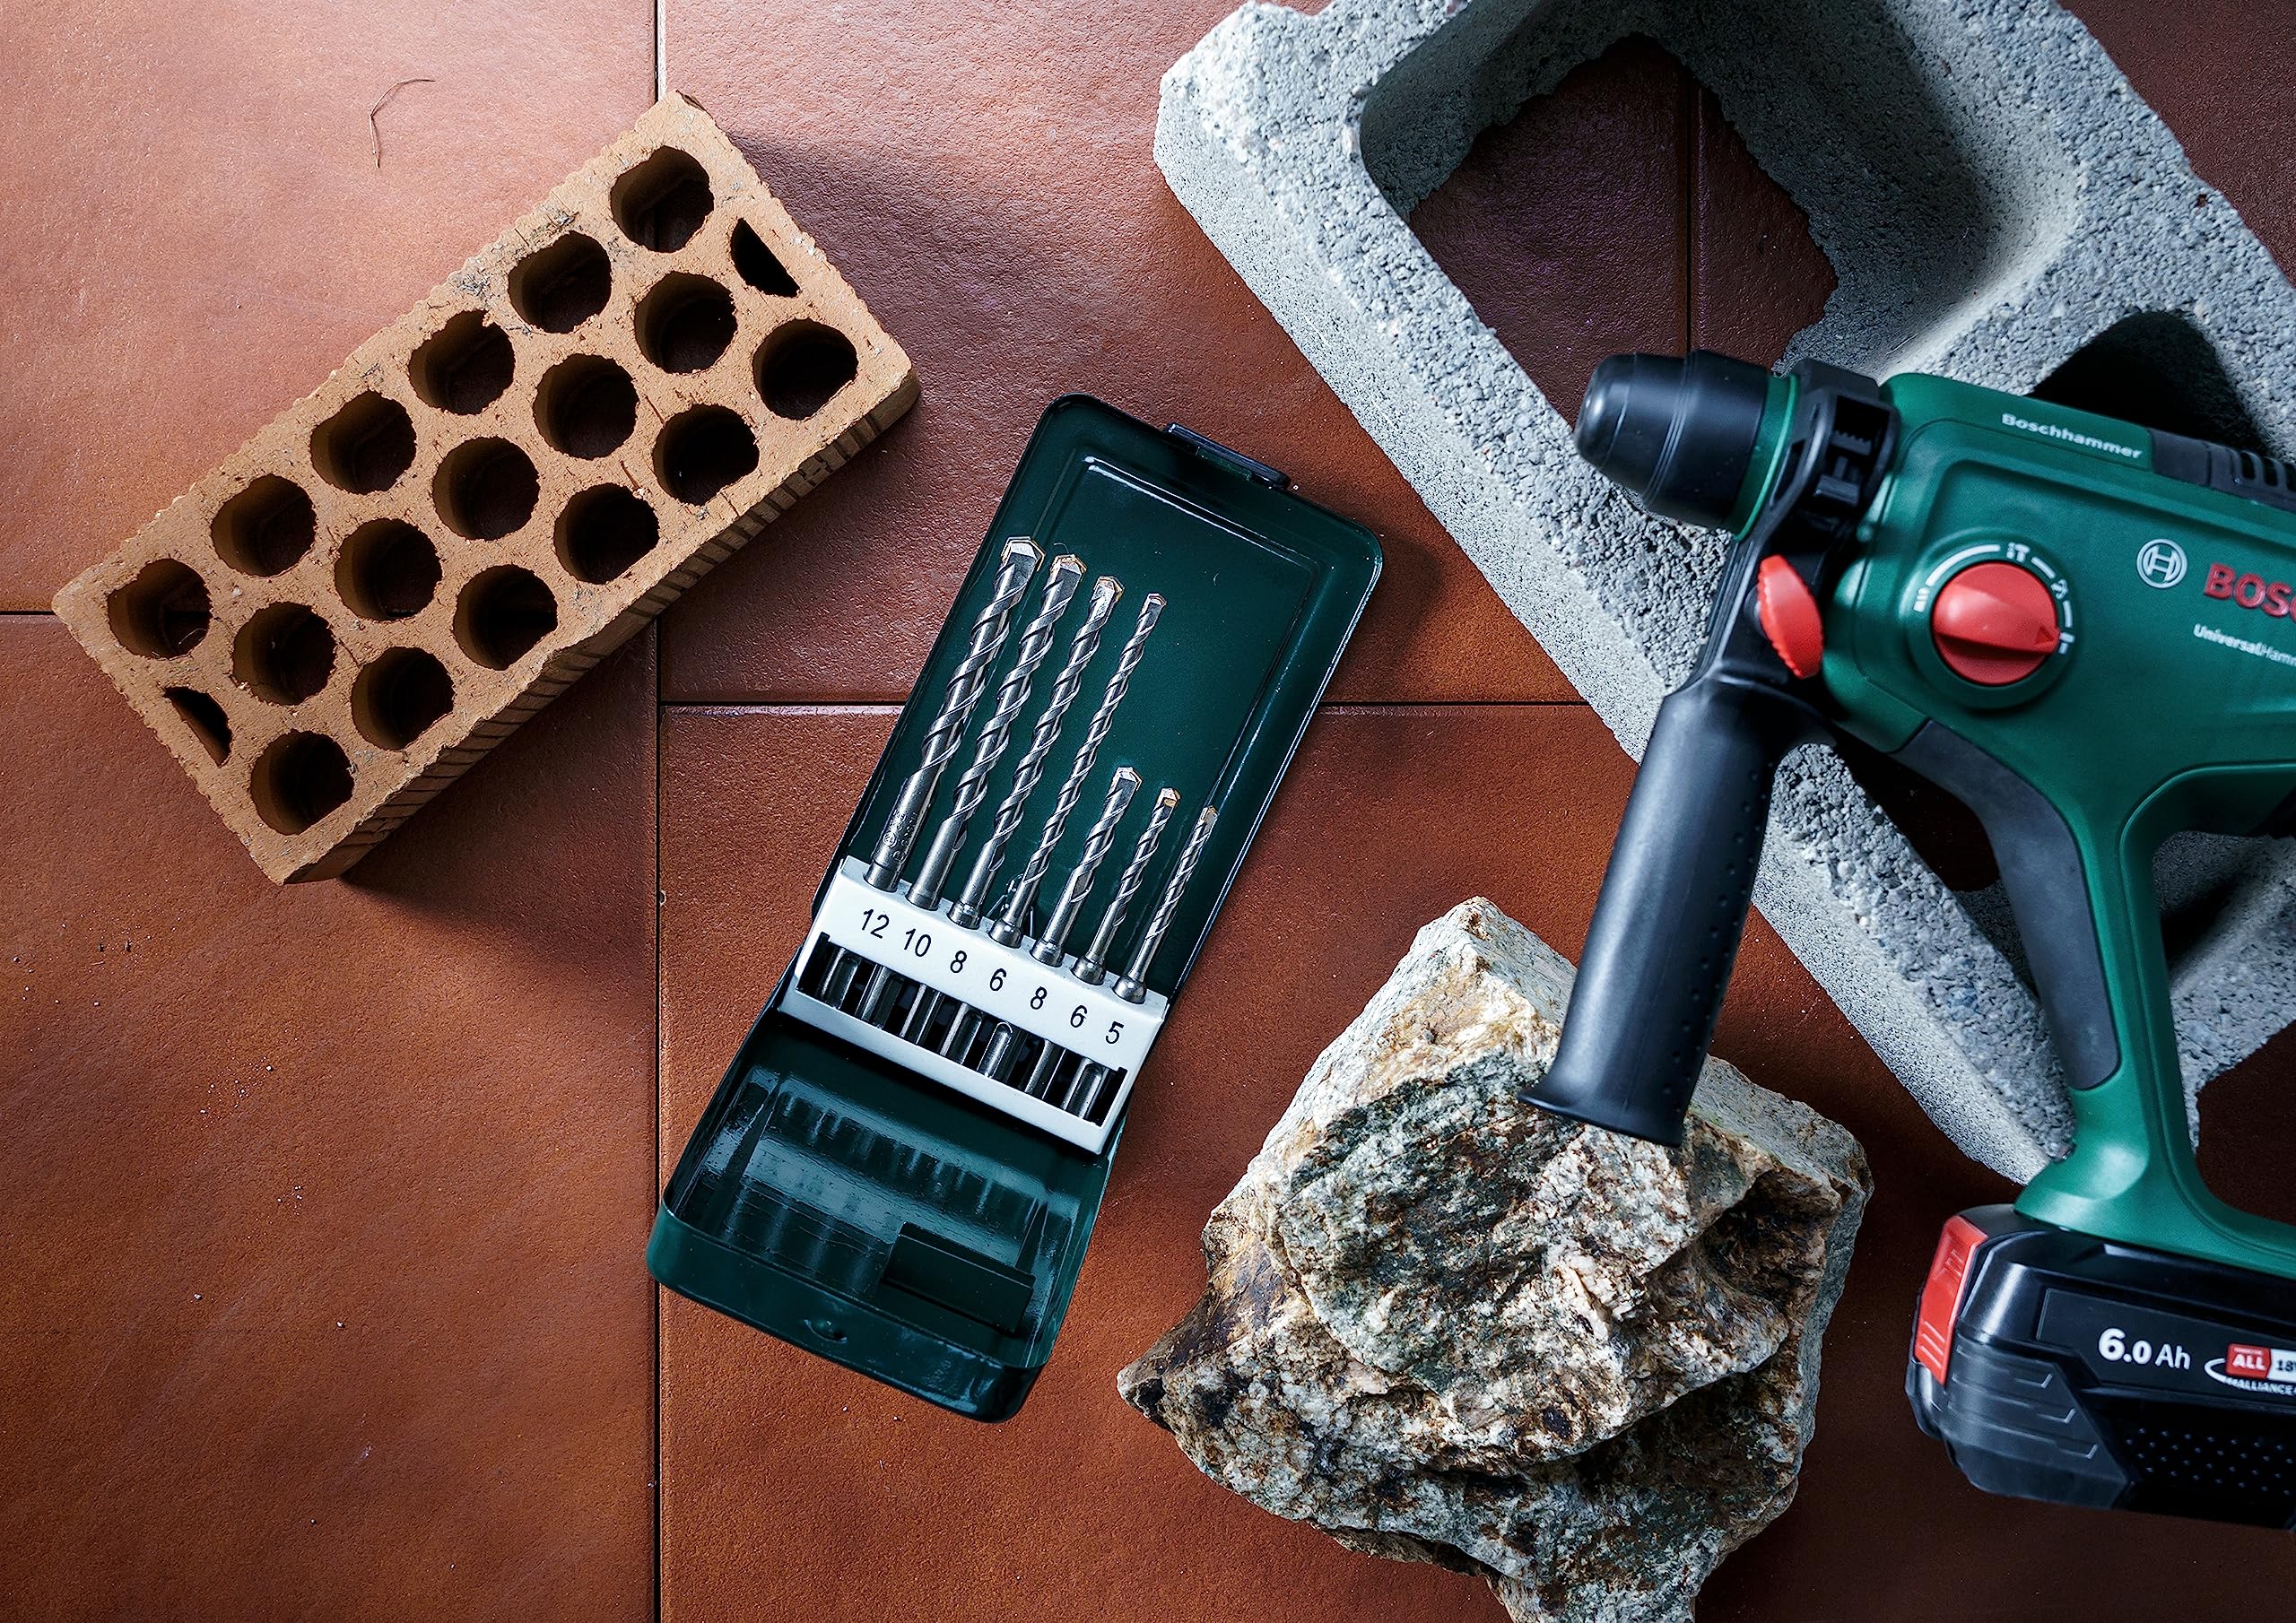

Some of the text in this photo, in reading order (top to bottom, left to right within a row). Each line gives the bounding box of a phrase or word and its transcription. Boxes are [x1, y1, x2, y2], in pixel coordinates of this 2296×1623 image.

[2001, 412, 2144, 459] Boschhammer
[2204, 562, 2296, 625] BOS
[861, 908, 1125, 1045] 12 10 8 6 8 6 5
[2098, 1327, 2191, 1370] 6.0 Ah
[2231, 1353, 2296, 1372] ALL 18
[2238, 1379, 2294, 1396] ALLIANCE
